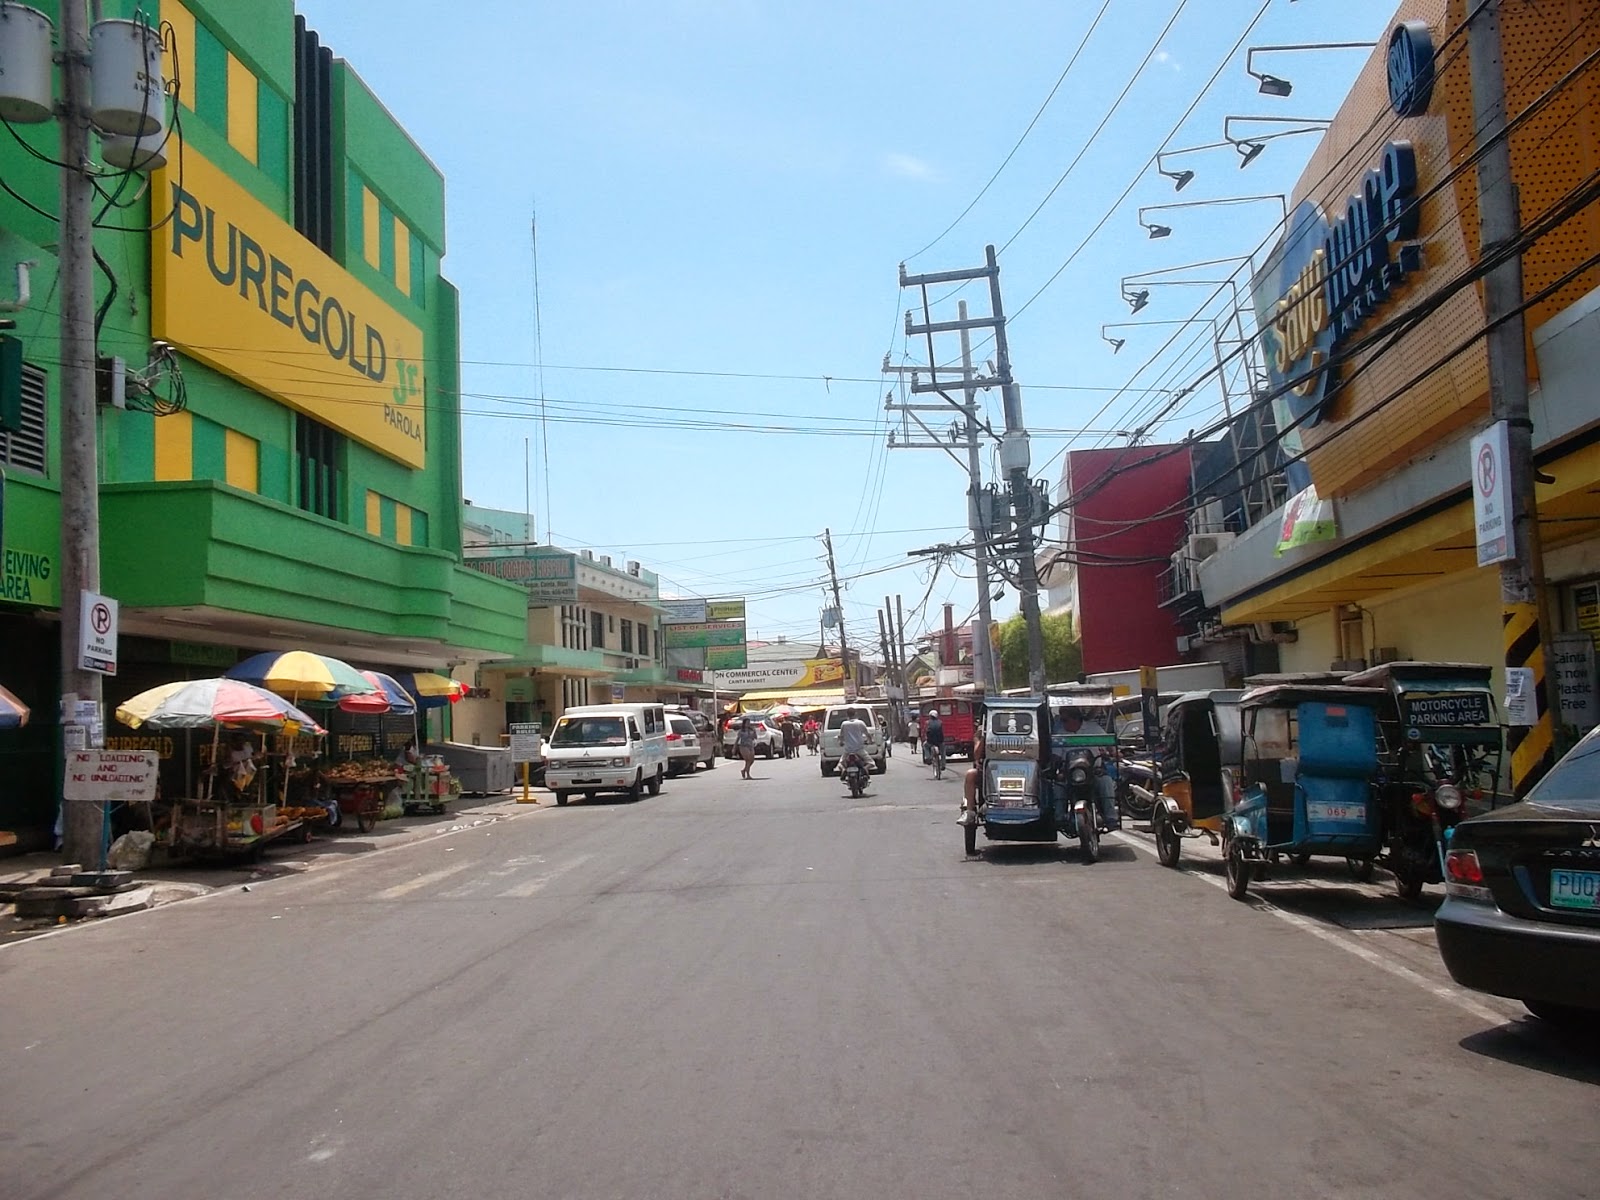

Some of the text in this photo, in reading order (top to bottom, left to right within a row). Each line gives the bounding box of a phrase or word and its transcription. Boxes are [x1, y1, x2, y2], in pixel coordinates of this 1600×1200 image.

[171, 181, 387, 384] PUREGOLD
[384, 403, 421, 442] PAROLA
[1484, 503, 1493, 515] NO
[1479, 516, 1502, 534] PARKING
[3, 550, 50, 580] EIVING
[502, 559, 535, 578] DOCTORS
[537, 557, 572, 577] HOSPITAL
[0, 575, 31, 601] AREA
[95, 637, 105, 645] NO
[87, 644, 113, 656] PARKING
[726, 669, 771, 678] COMMERCIAL
[772, 668, 798, 676] CENTER
[1565, 669, 1588, 680] now
[1411, 698, 1481, 712] MOTORCYCLE
[1561, 699, 1587, 710] Free
[1410, 710, 1486, 724] PARKING AREA
[76, 754, 145, 763] NO LOADING
[73, 774, 144, 783] NO UNLOADING
[1327, 807, 1347, 817] 069
